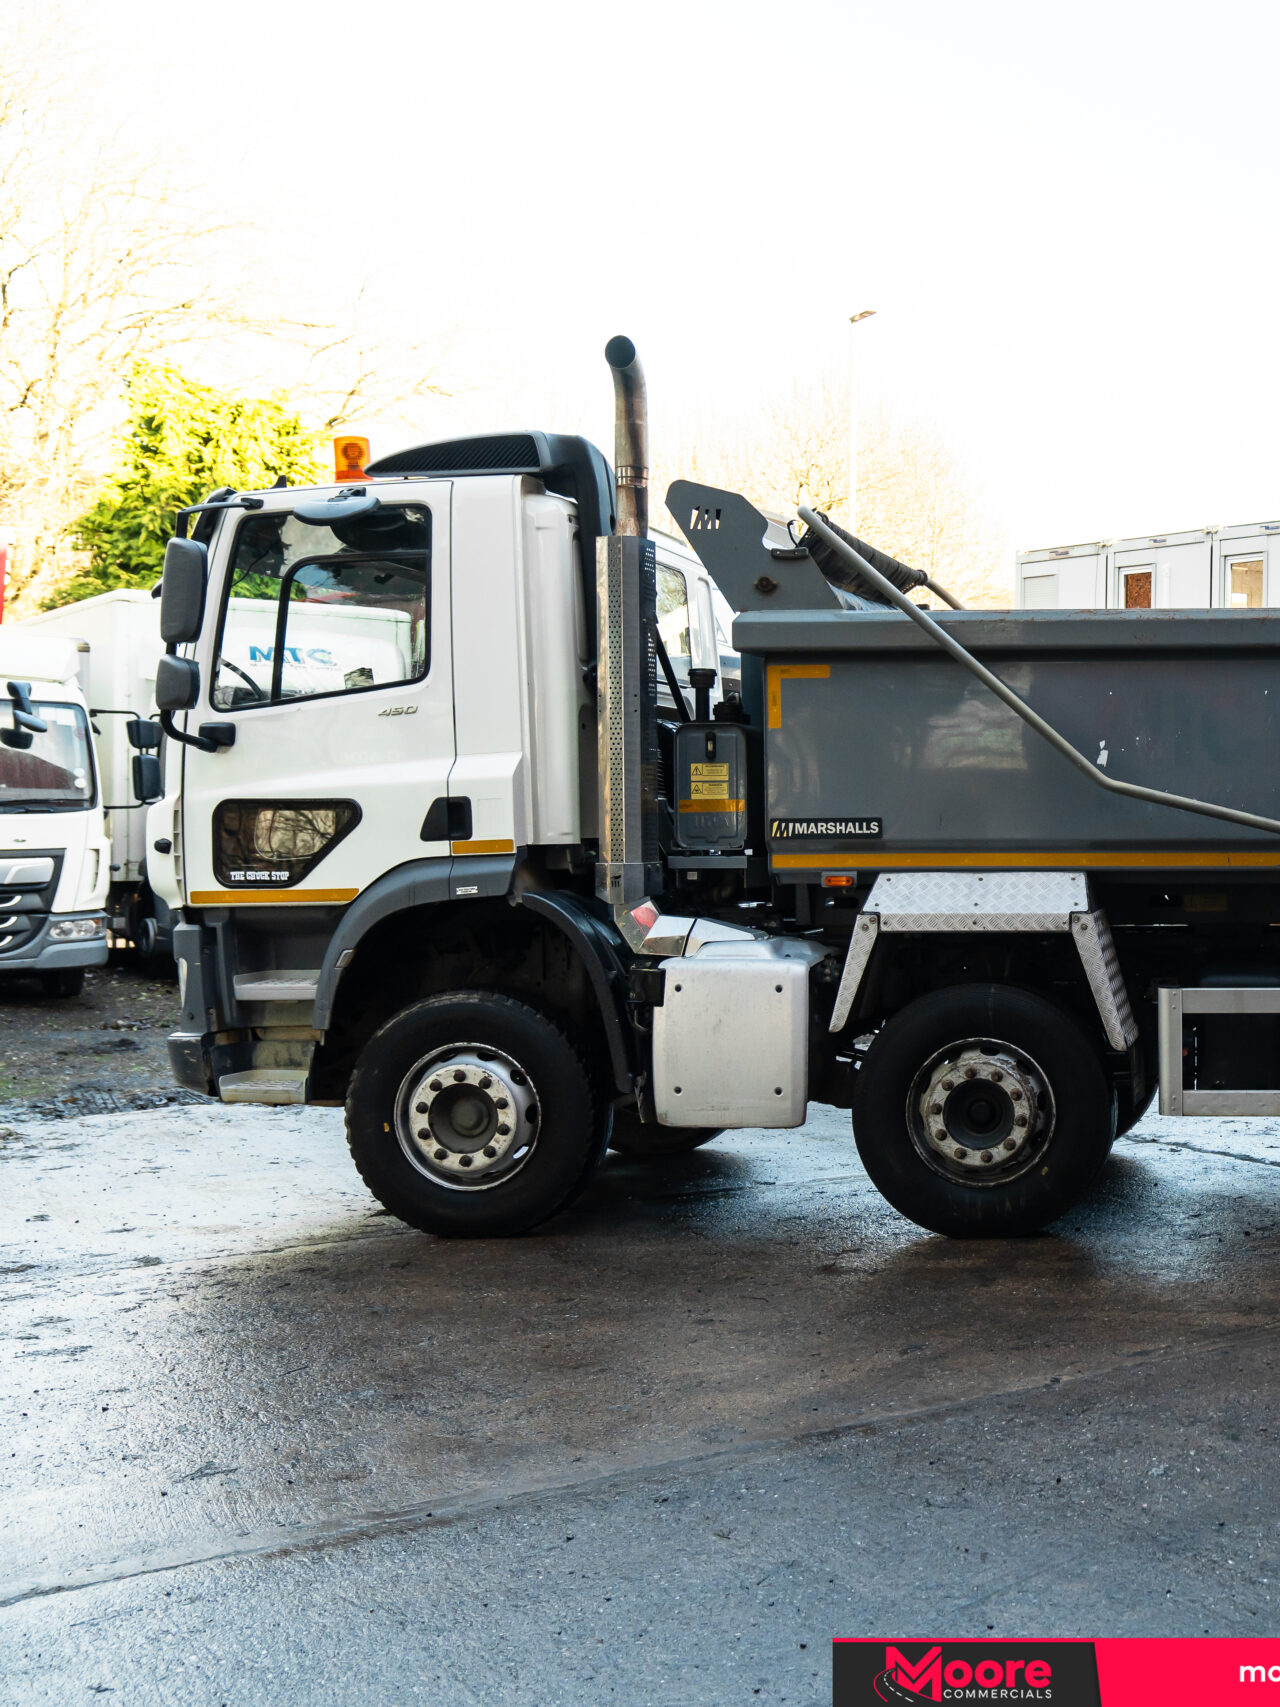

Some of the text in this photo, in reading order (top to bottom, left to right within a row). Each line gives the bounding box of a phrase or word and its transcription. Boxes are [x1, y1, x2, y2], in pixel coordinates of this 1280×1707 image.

[378, 705, 418, 716] 450
[794, 822, 879, 835] MARSHALLS
[230, 871, 245, 881] THE
[271, 871, 290, 881] STOP
